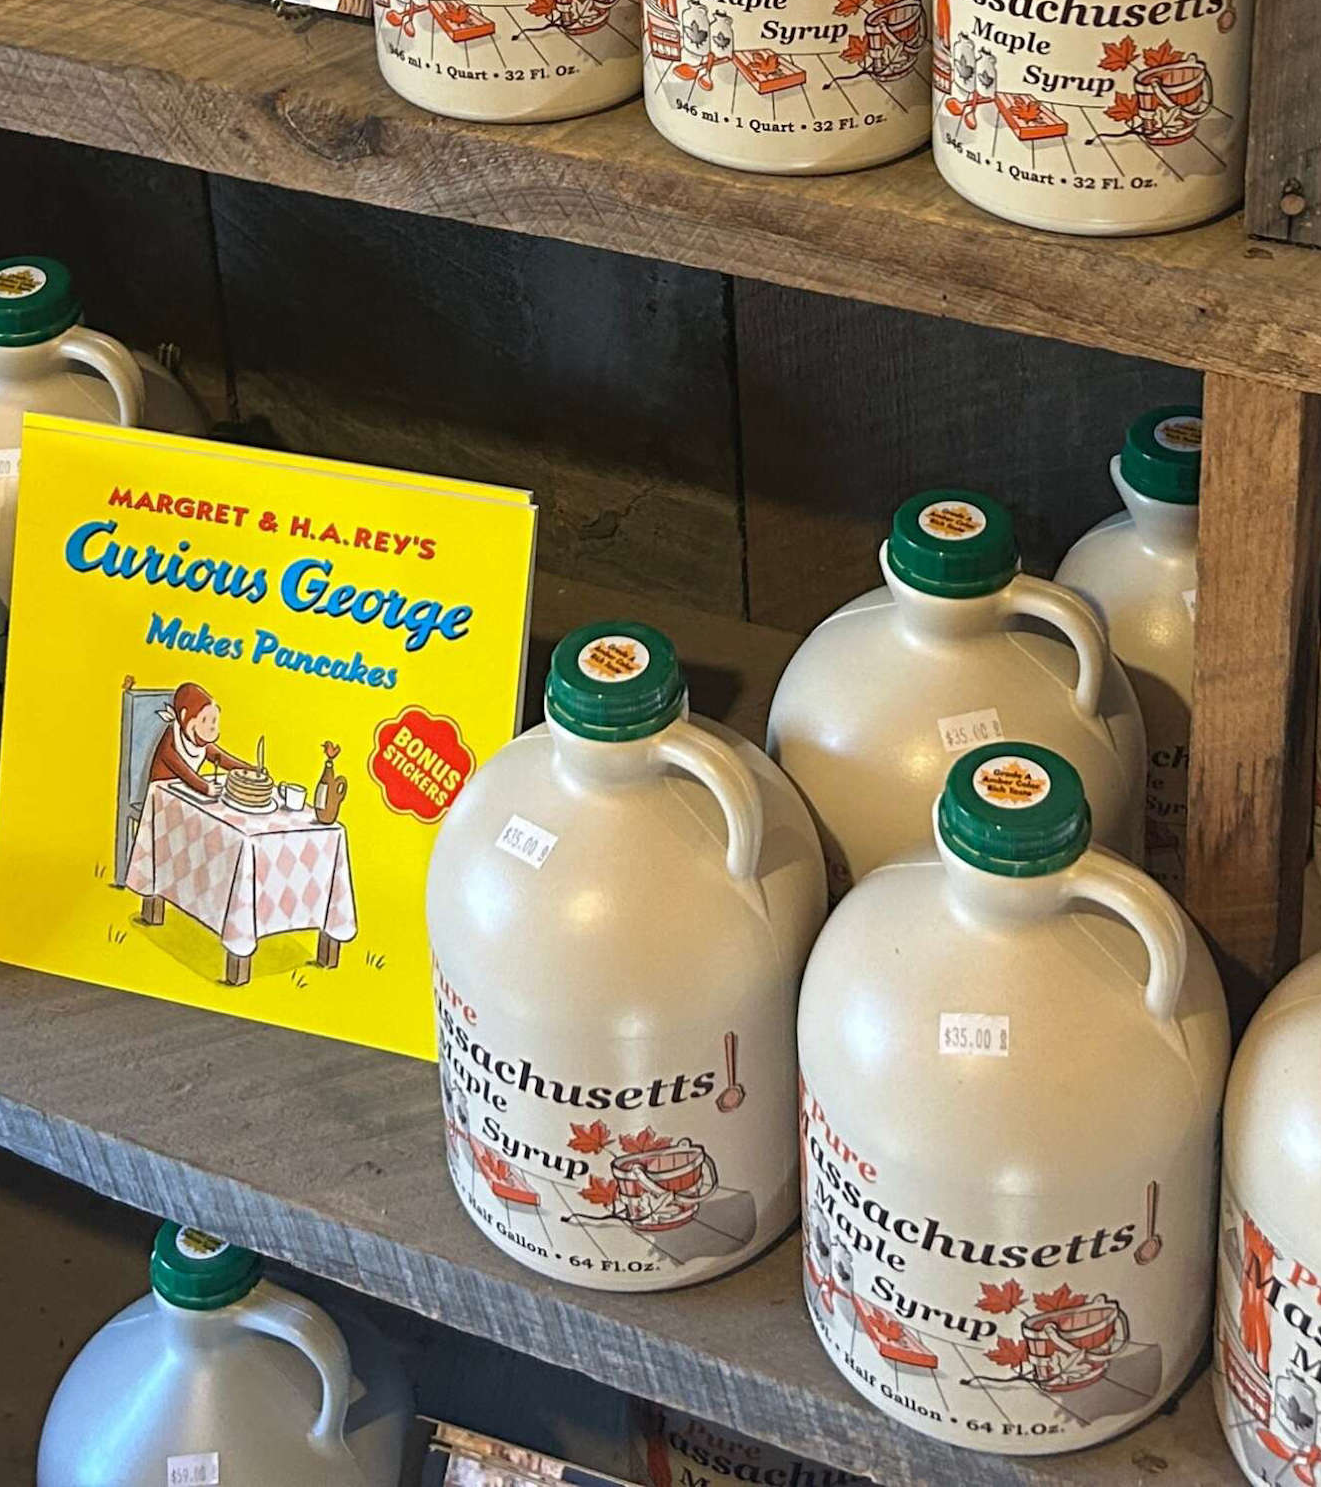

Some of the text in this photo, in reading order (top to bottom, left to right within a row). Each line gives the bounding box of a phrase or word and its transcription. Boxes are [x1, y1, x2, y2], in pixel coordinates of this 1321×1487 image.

[108, 487, 249, 526] MARGRET
[259, 511, 278, 532] &
[65, 520, 473, 652] Curious George
[147, 612, 397, 690] Makes Pancakes
[382, 744, 449, 807] STICKERS
[392, 726, 461, 791] BONUS
[481, 1117, 590, 1180] Syrup
[496, 1223, 548, 1258] Gallon
[569, 1256, 593, 1269] 64
